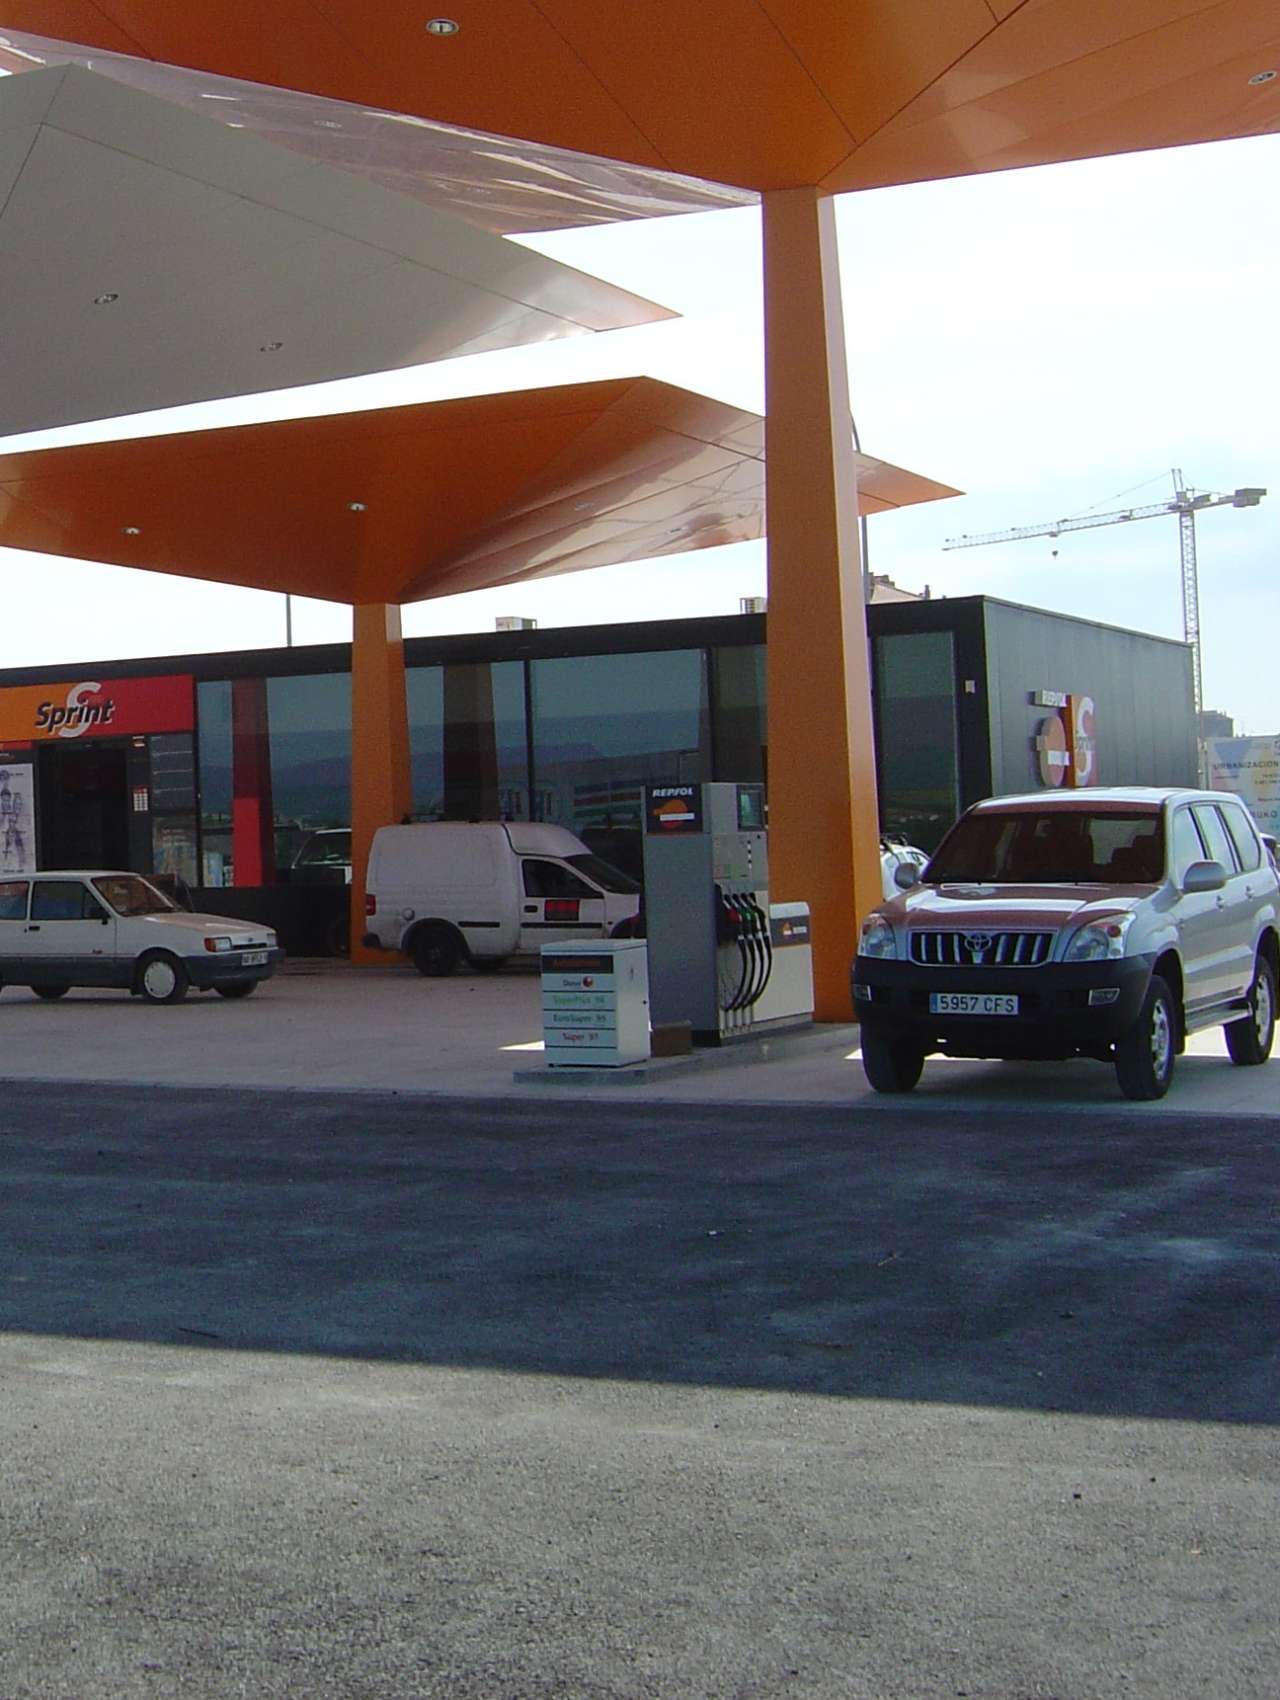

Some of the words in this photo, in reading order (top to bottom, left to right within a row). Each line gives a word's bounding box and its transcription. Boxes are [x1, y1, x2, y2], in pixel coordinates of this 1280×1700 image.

[35, 699, 115, 735] Sprint
[652, 787, 694, 797] REPSOL
[940, 995, 978, 1012] 5957
[984, 997, 1015, 1013] CFS
